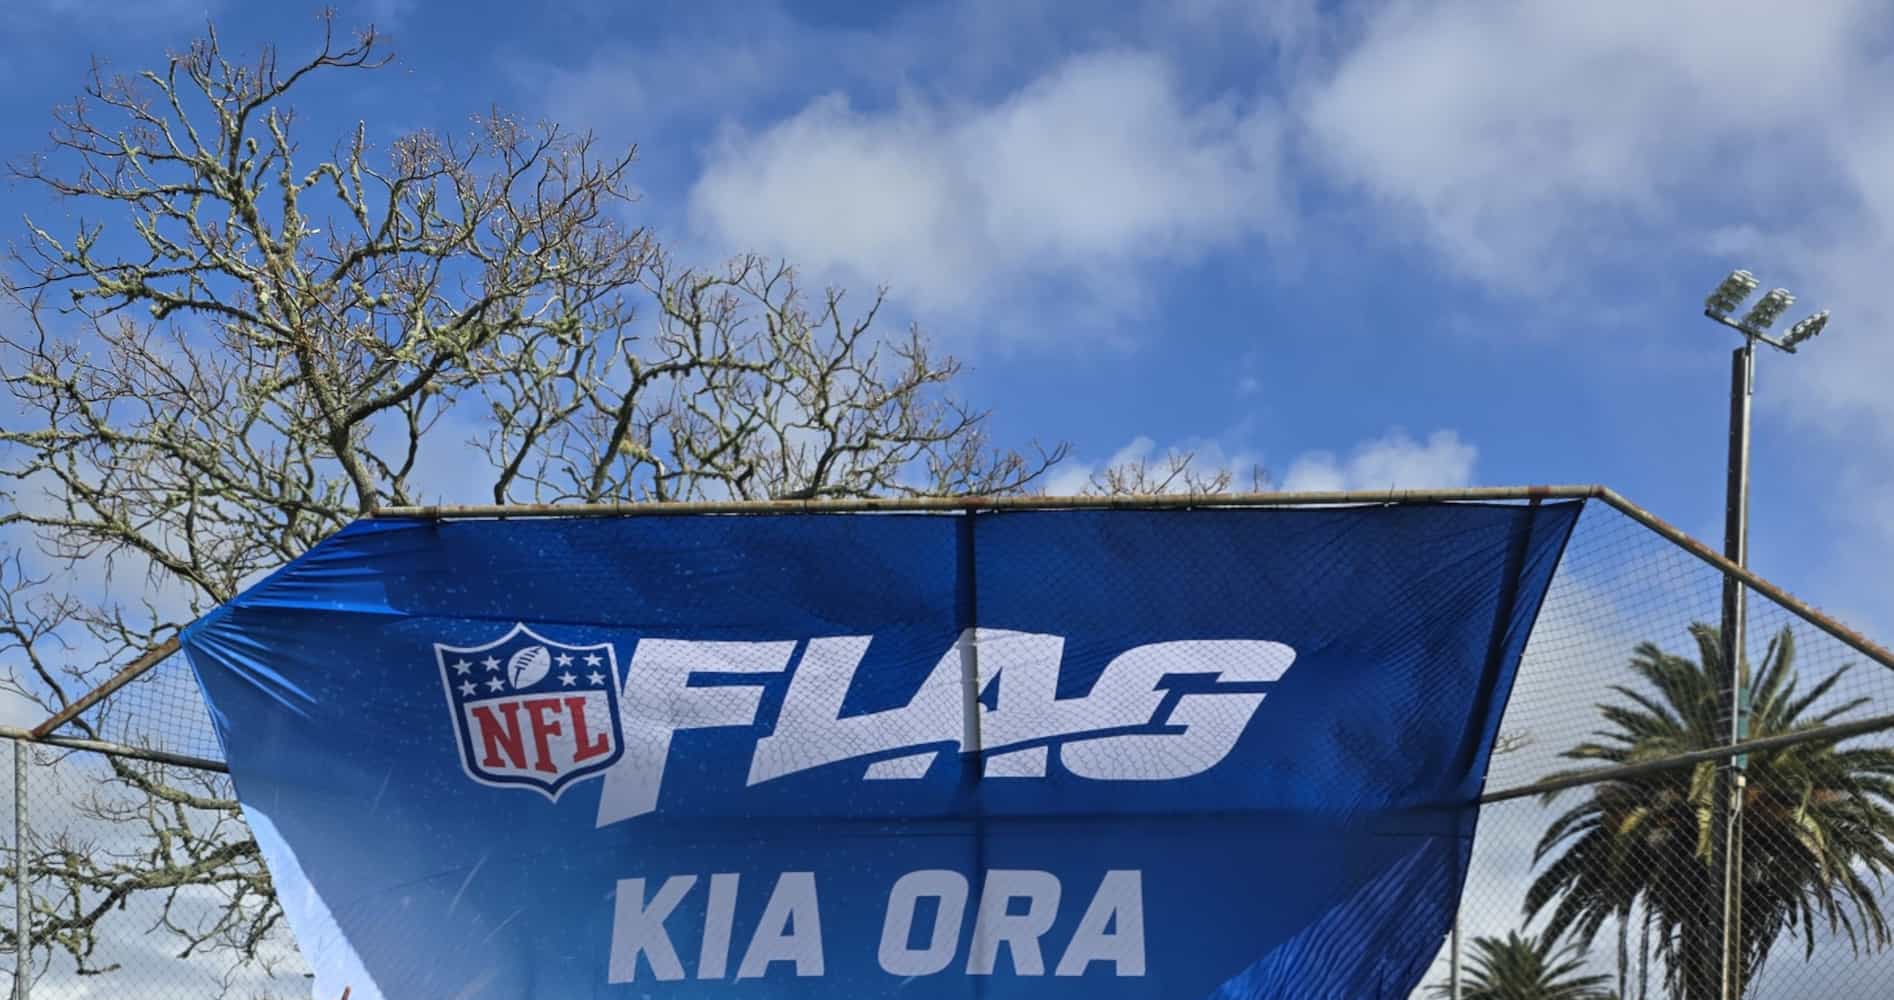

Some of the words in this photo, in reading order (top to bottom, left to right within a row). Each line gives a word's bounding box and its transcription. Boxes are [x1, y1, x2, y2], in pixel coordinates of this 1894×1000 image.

[472, 696, 609, 773] NFL
[596, 627, 1297, 828] FLAG
[608, 871, 825, 984] KIA
[877, 868, 1147, 977] ORA
